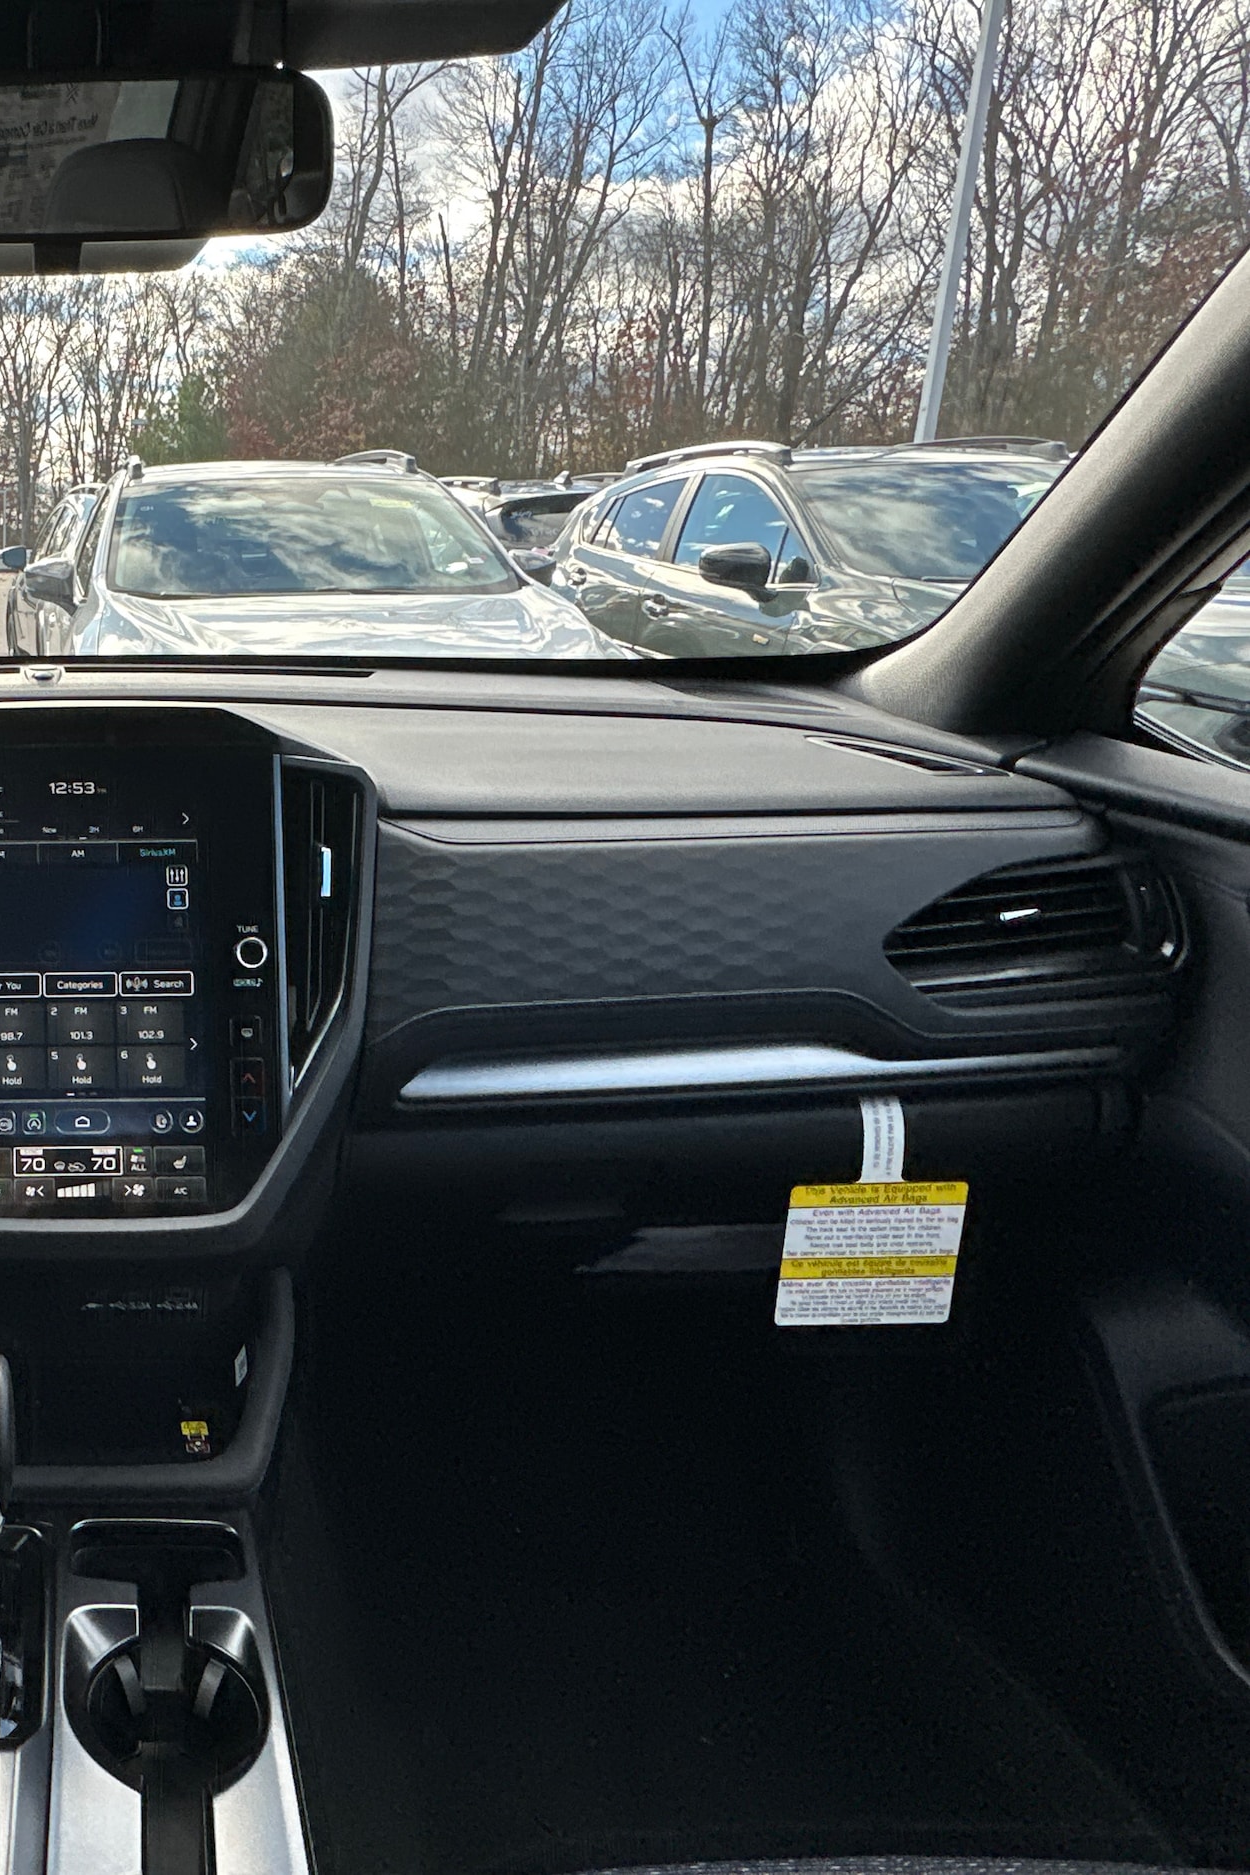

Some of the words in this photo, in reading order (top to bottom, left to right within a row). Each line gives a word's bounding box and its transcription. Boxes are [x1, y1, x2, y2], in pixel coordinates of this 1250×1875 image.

[48, 782, 96, 795] 12:53
[70, 850, 85, 858] AM
[139, 848, 176, 858] SiriusXM
[237, 925, 259, 933] TUNE
[5, 981, 22, 990] You
[56, 980, 104, 991] Categories
[153, 979, 185, 989] Search
[4, 1007, 19, 1016] FM
[50, 1007, 58, 1016] 2
[74, 1006, 88, 1015] FM
[119, 1006, 128, 1015] 3
[143, 1006, 158, 1015] FM
[0, 1032, 24, 1041] 98.7
[69, 1031, 93, 1040] 101.3
[138, 1030, 165, 1039] 102.9
[50, 1052, 59, 1060] 5
[120, 1051, 129, 1060] 6
[1, 1076, 22, 1085] Hold
[72, 1076, 92, 1085] Hold
[141, 1075, 162, 1084] Hold
[20, 1157, 46, 1172] 70
[90, 1157, 116, 1171] 70
[130, 1163, 147, 1172] ALL
[173, 1186, 188, 1195] A/C
[883, 1184, 932, 1196] Equipped
[936, 1183, 957, 1192] with
[829, 1195, 880, 1204] Advanced
[883, 1194, 899, 1203] Air
[902, 1193, 928, 1205] Bags
[812, 1209, 835, 1217] Even
[838, 1208, 855, 1216] with
[857, 1207, 901, 1216] Advanced
[904, 1207, 916, 1215] Air
